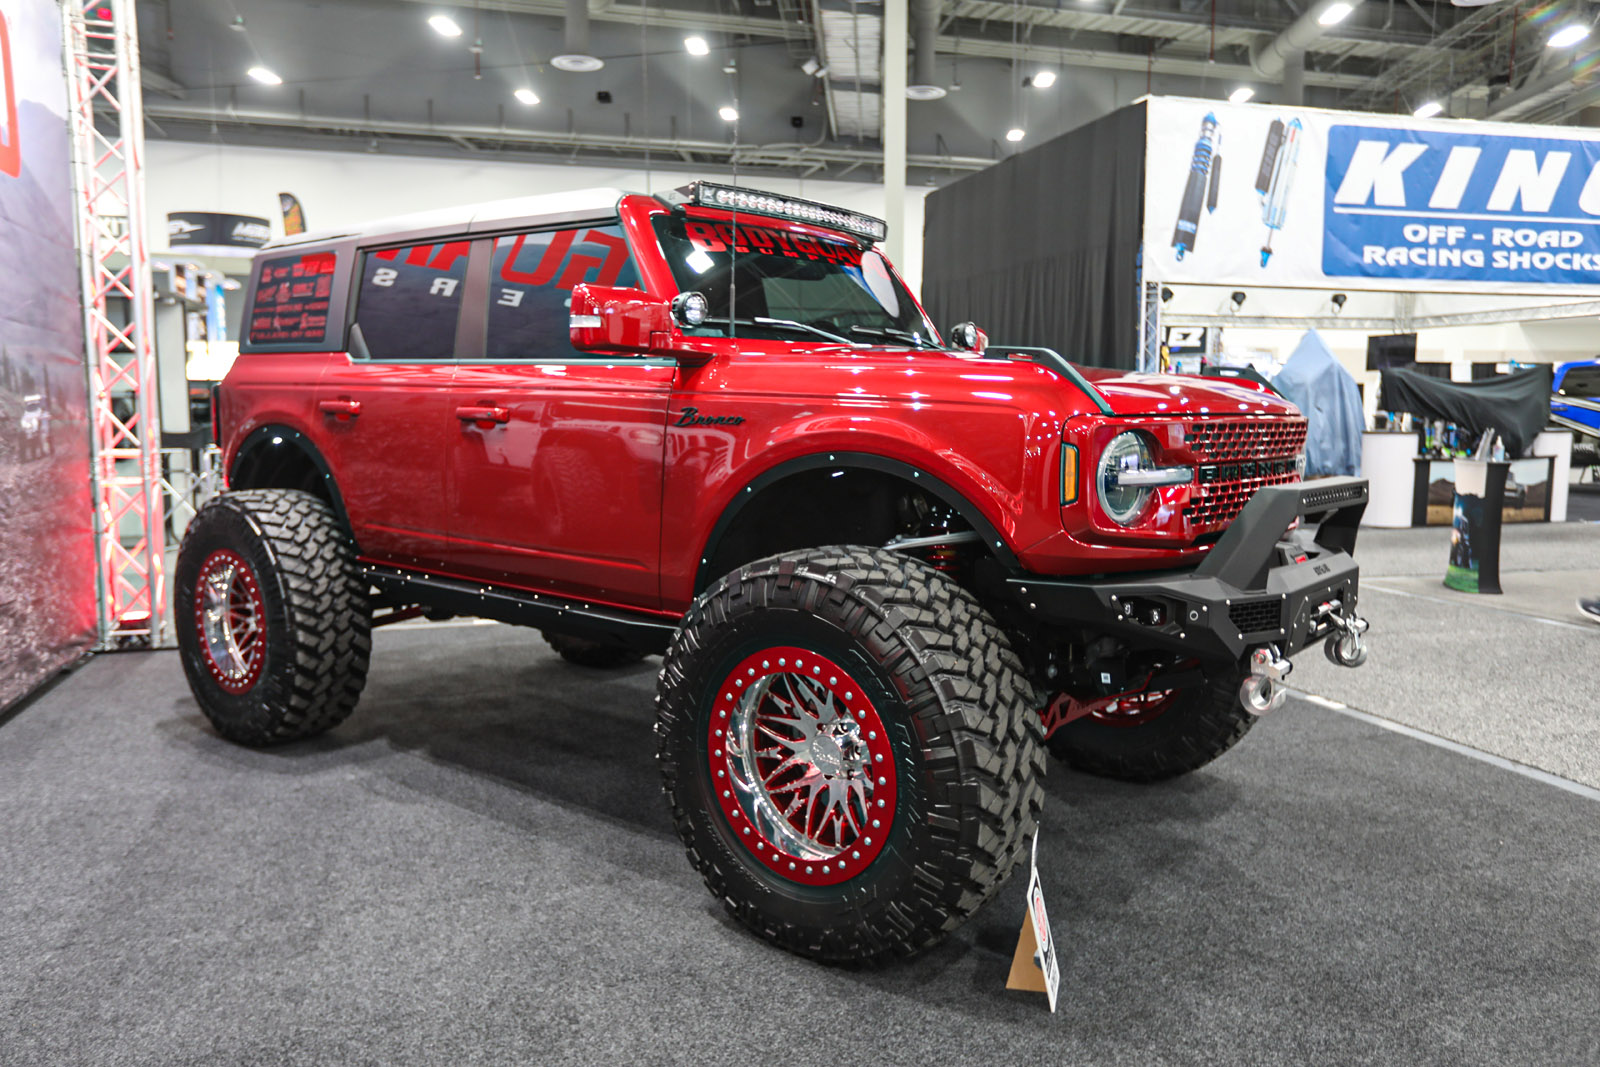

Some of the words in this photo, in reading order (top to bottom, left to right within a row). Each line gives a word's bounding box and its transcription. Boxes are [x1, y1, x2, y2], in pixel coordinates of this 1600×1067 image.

[1402, 224, 1467, 246] OFF
[1491, 227, 1584, 249] ROAD
[1362, 245, 1485, 268] RACING
[673, 406, 746, 427] Bronco
